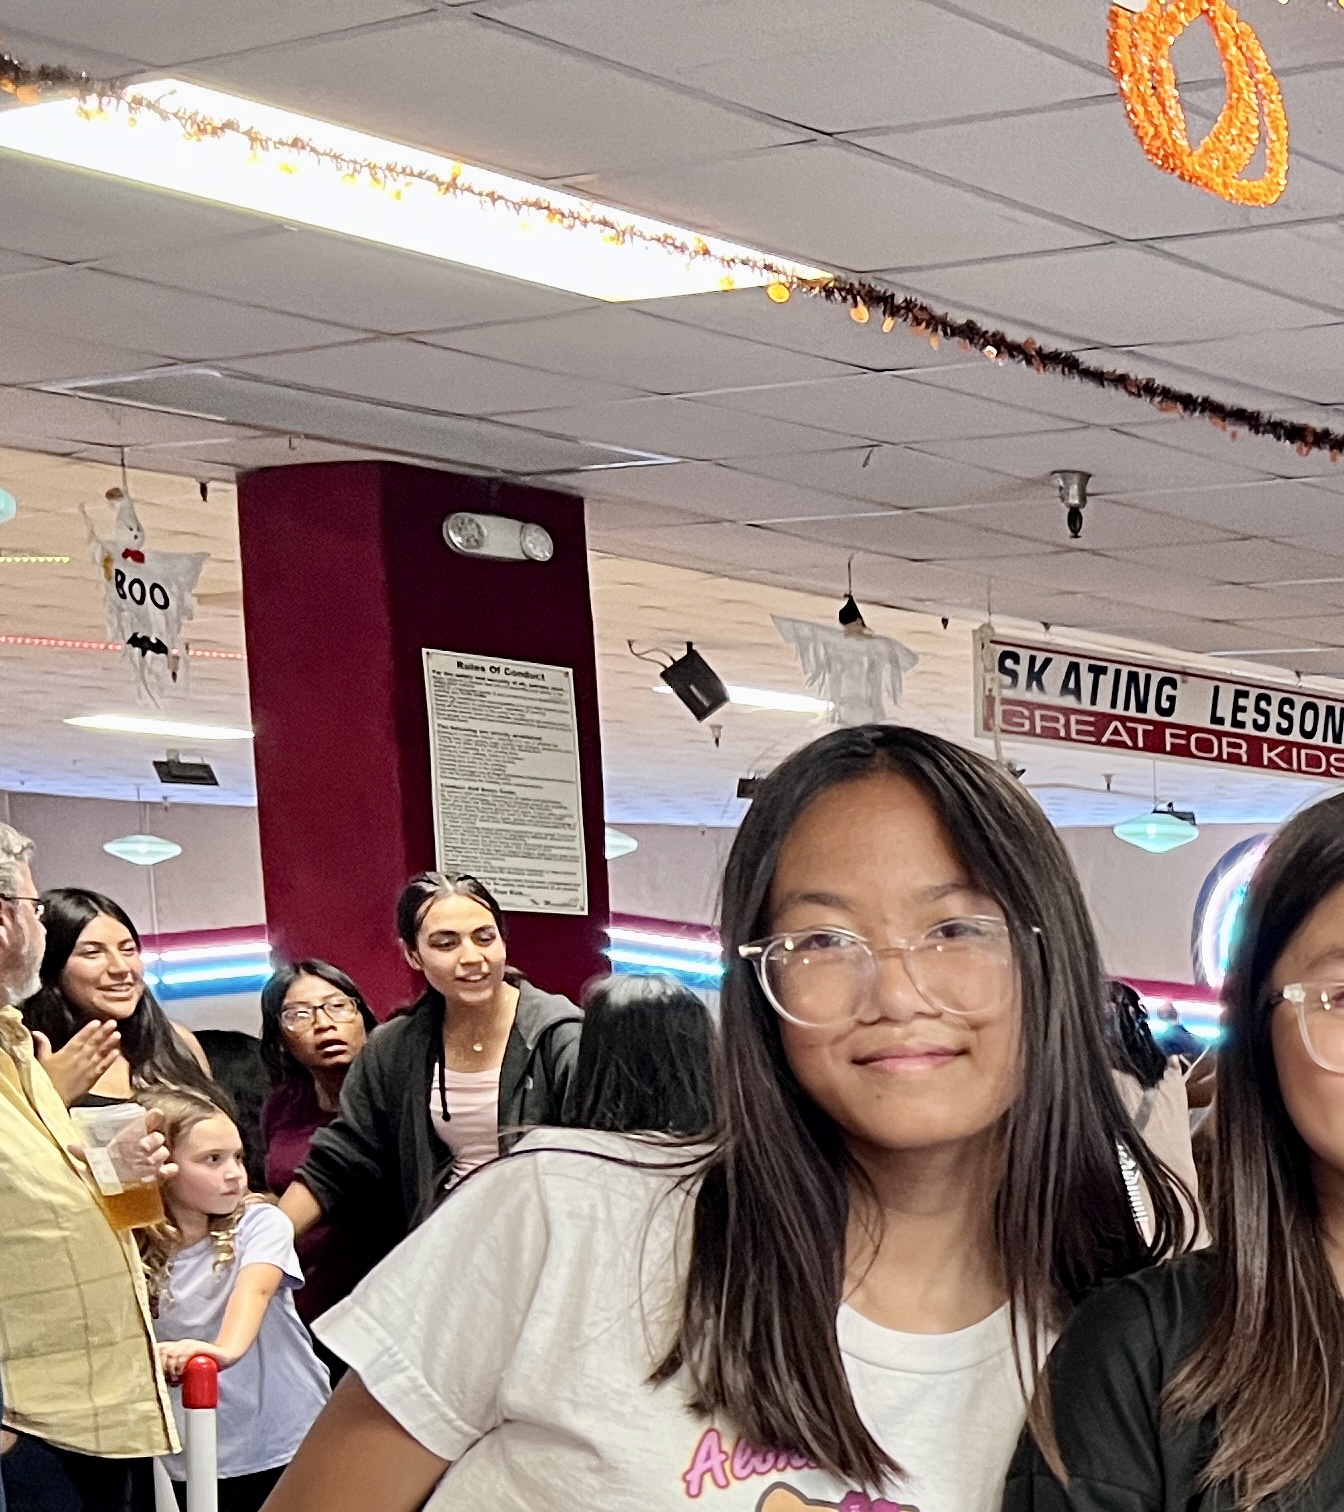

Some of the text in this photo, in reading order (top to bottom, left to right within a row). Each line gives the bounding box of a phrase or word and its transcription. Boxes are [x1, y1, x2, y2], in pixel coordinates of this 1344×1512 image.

[114, 568, 170, 610] BOO
[456, 660, 486, 673] Rules
[489, 665, 501, 675] Of
[504, 667, 546, 682] Conduct
[997, 649, 1178, 718] SKATING
[1001, 704, 1154, 749] GREAT
[1164, 728, 1249, 764] FOR
